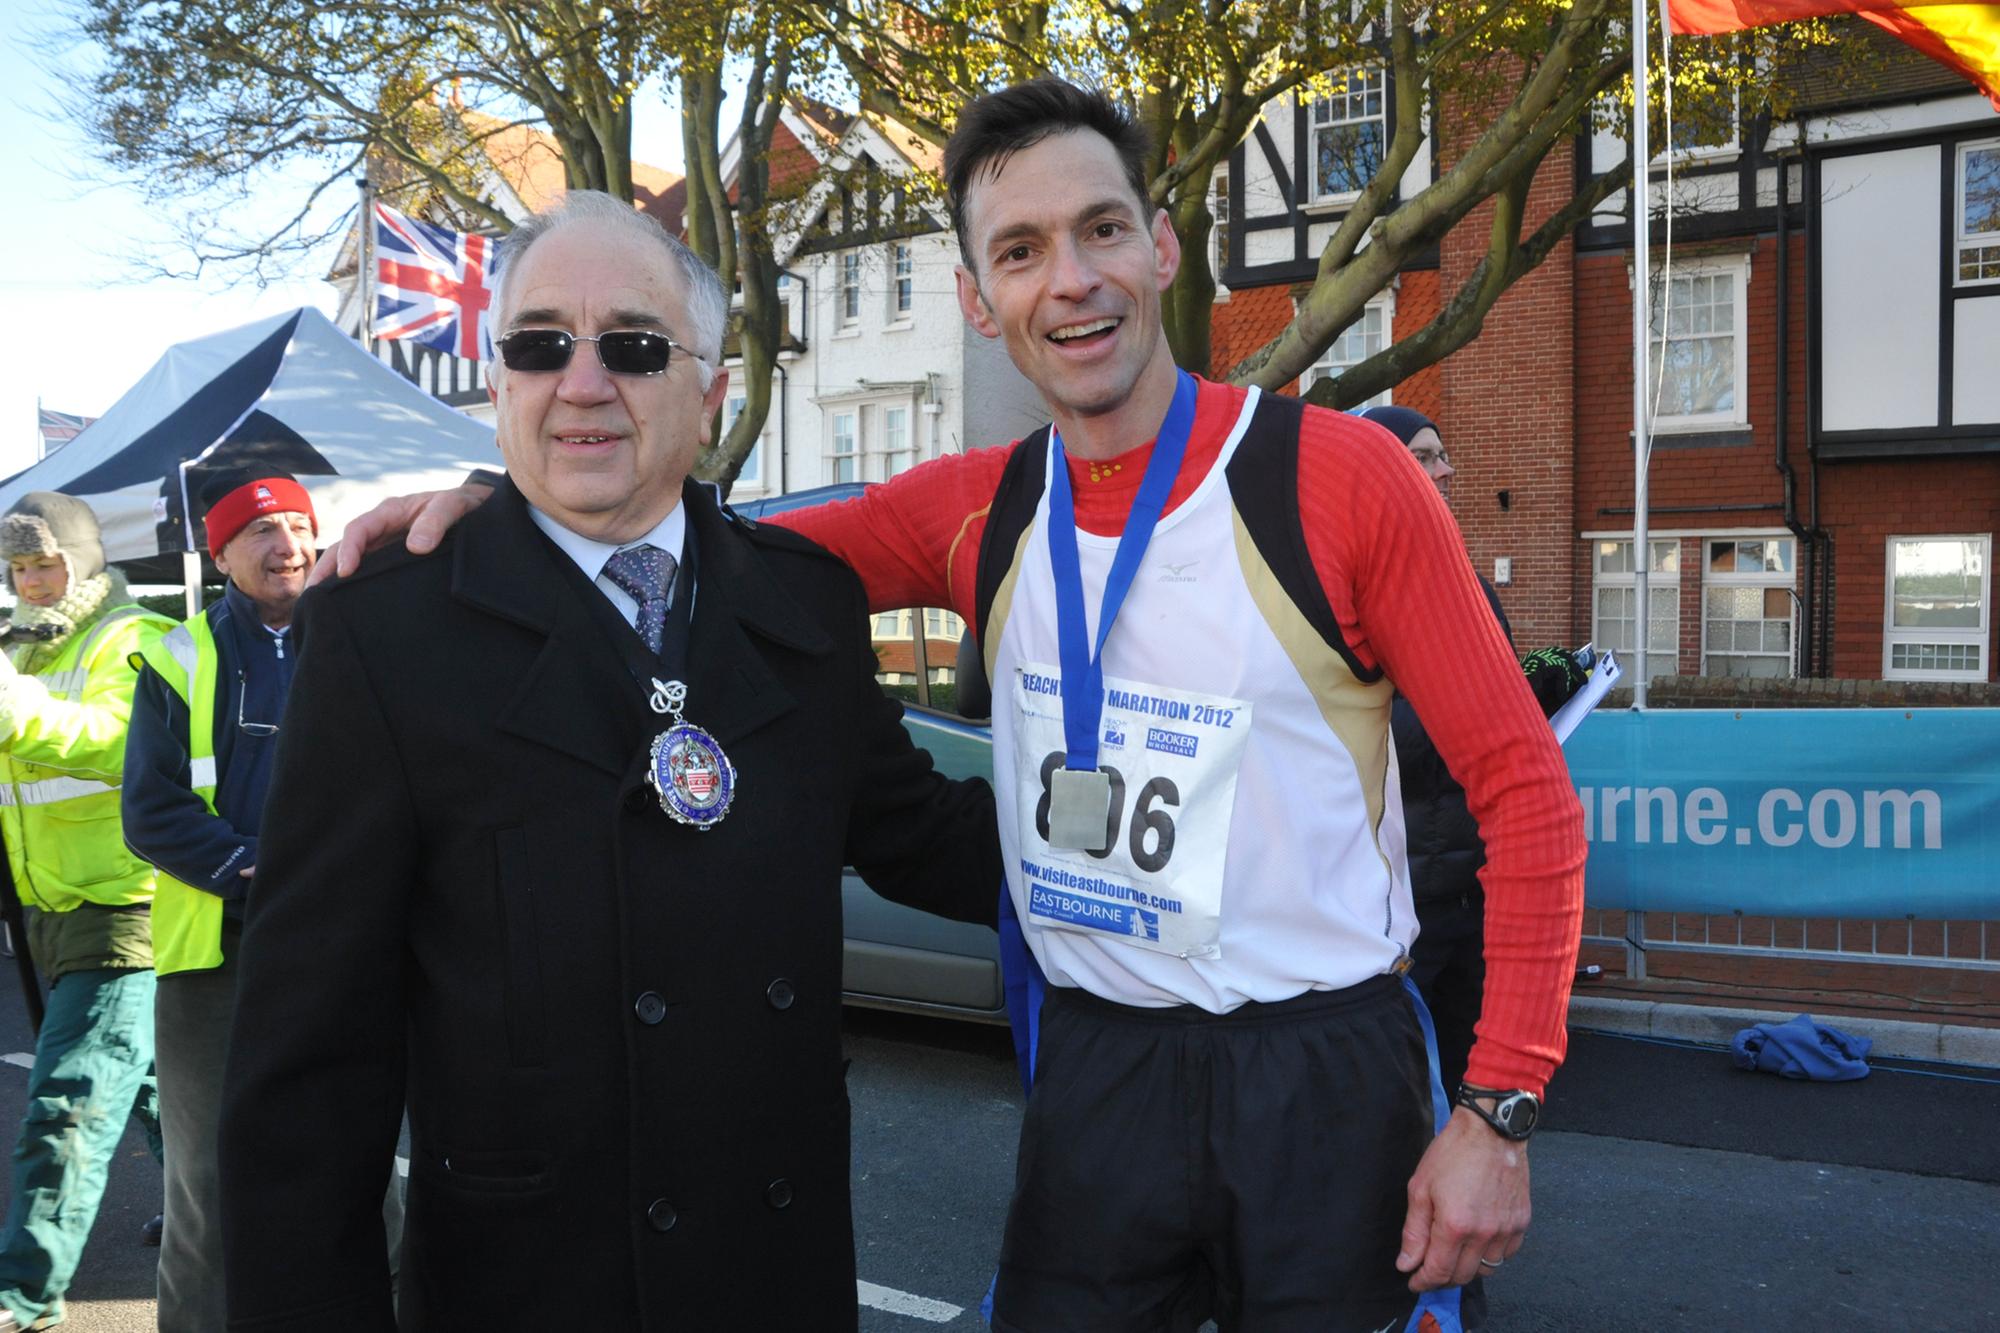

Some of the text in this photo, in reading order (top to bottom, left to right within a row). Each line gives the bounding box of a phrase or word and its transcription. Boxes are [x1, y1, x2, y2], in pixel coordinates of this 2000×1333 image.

[1023, 673, 1064, 697] BEACH
[1108, 689, 1190, 721] MARATHON
[1193, 704, 1234, 728] 2012
[1147, 740, 1194, 756] WHOLESALE
[1149, 729, 1196, 749] BOOKER
[1032, 889, 1122, 924] EASTBOURNE
